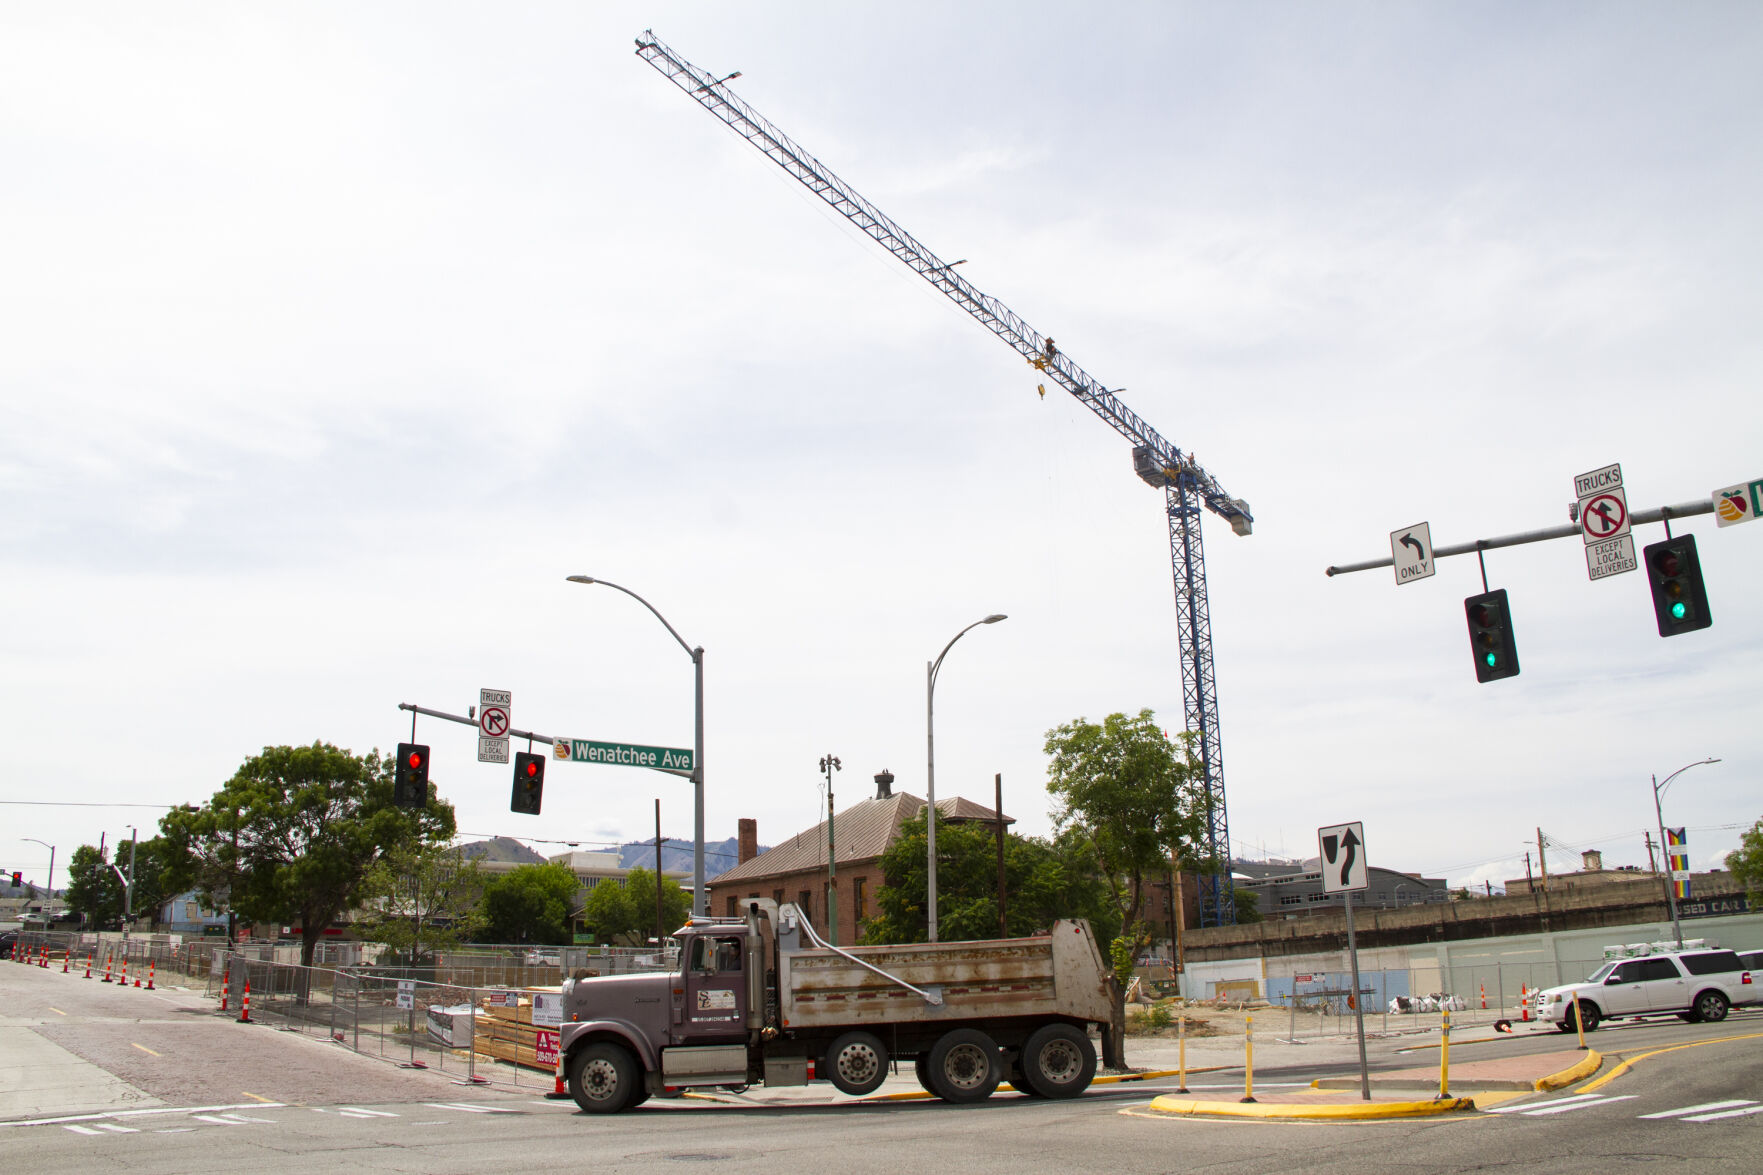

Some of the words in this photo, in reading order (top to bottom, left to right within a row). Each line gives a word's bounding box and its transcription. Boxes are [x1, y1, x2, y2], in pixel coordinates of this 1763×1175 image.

[1577, 468, 1620, 493] TRUCKS
[1595, 539, 1623, 556] EXCEPT
[1597, 550, 1625, 566] LOCAL
[1400, 561, 1428, 579] ONLY
[1592, 559, 1634, 577] DELIVERIES
[482, 692, 510, 704] TRUCKS
[484, 740, 503, 748] EXCEPT
[575, 742, 657, 766] Wenatchee
[661, 750, 690, 769] Ave
